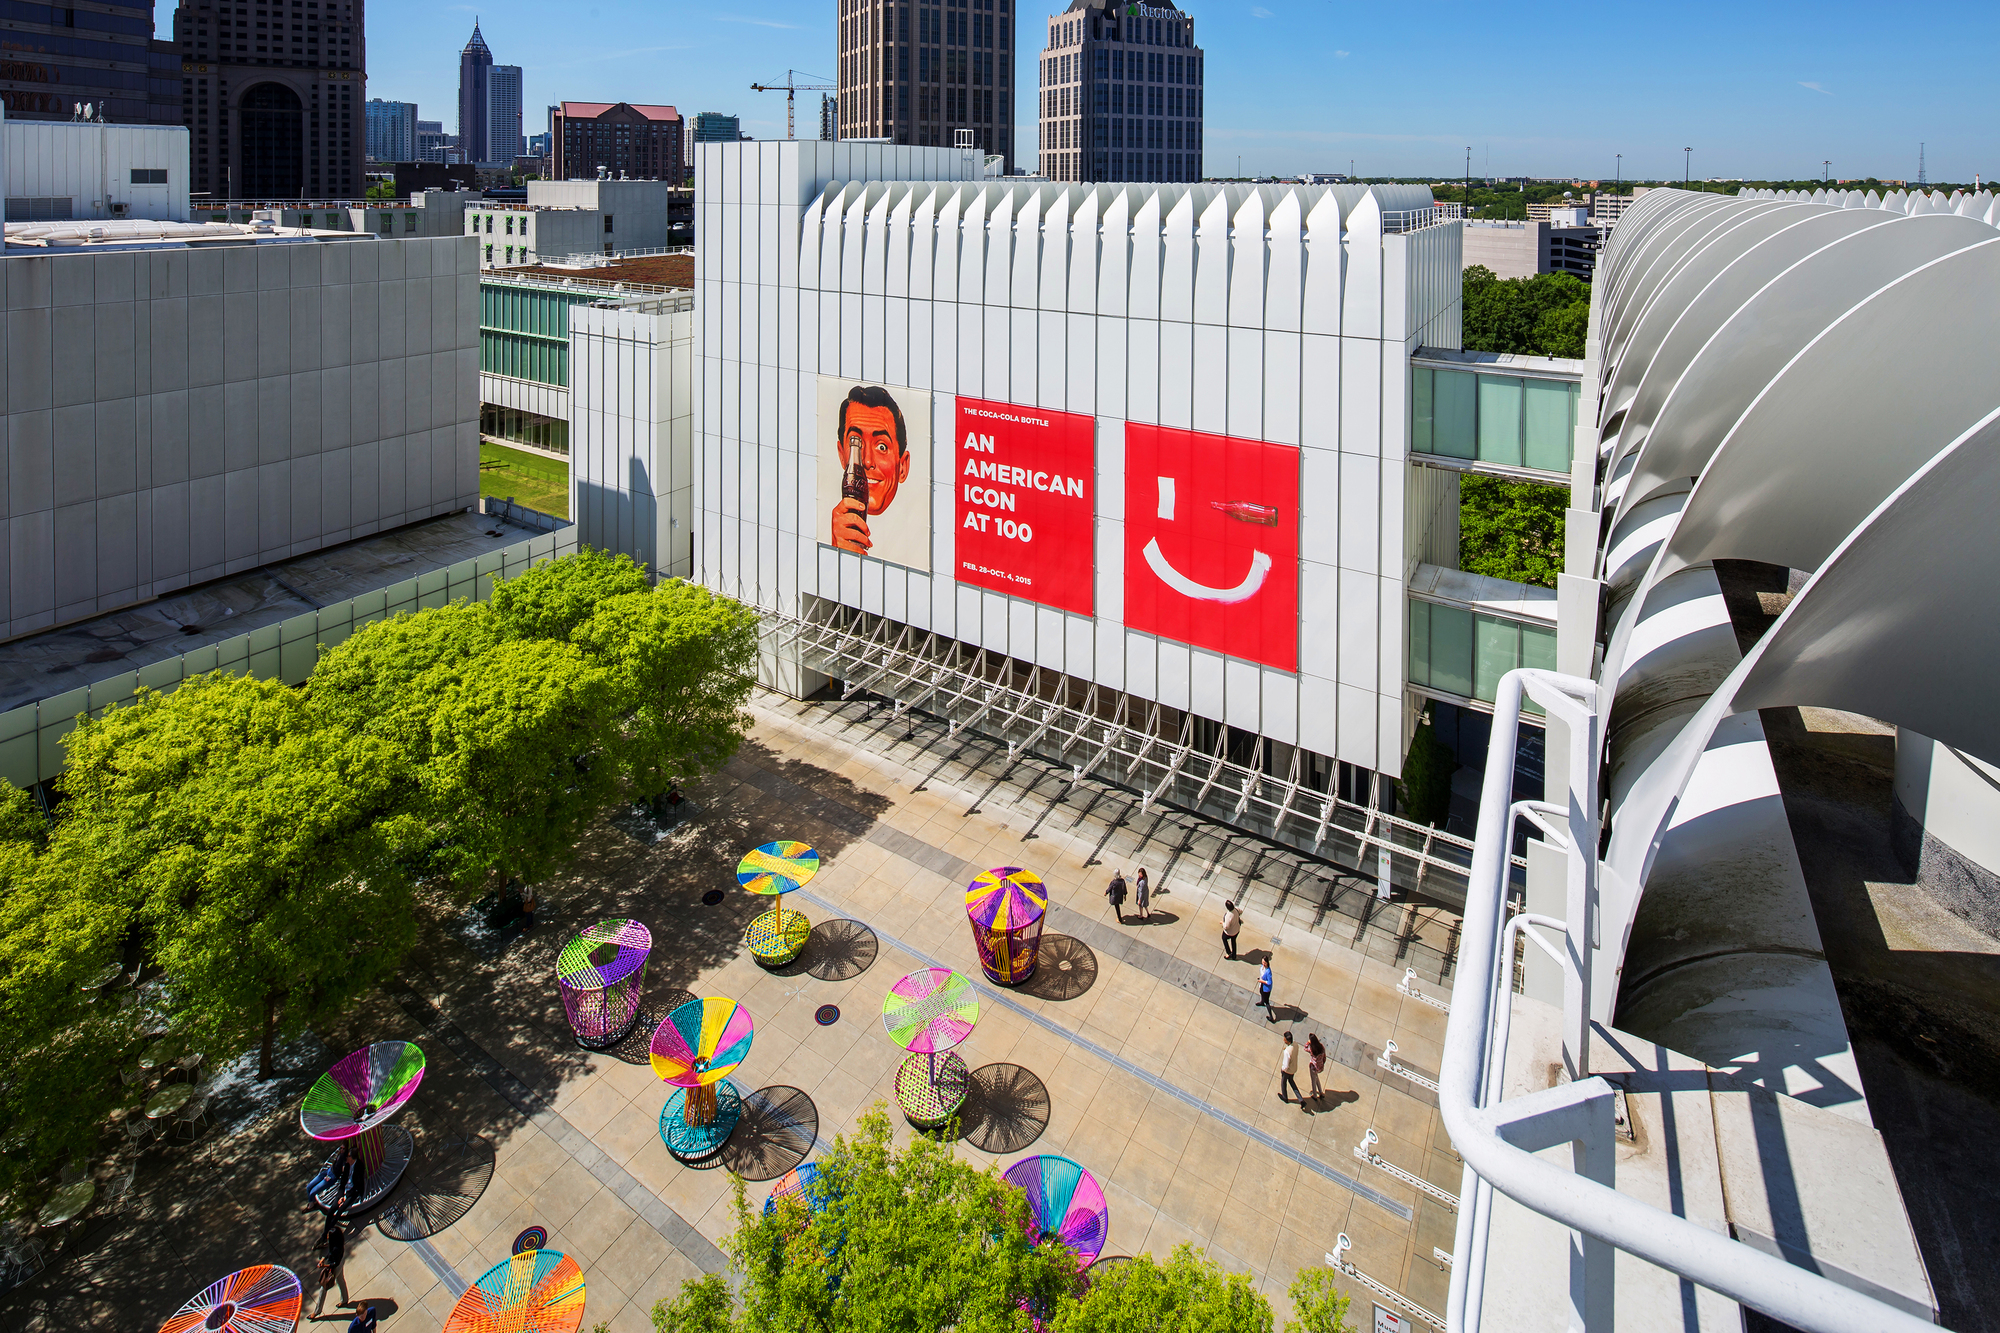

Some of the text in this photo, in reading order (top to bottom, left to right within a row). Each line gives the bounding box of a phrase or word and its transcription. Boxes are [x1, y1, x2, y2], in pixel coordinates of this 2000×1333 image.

[1140, 3, 1184, 21] REGIONS
[963, 407, 1050, 427] THE COCA-COLA BOTTLE
[963, 431, 995, 454] AN
[963, 458, 1084, 499] AMERICAN
[963, 483, 1016, 513] ICON
[962, 510, 1033, 543] AT 100
[962, 561, 978, 572] FEB.
[1006, 573, 1014, 582] 4,
[1015, 575, 1032, 586] 2015
